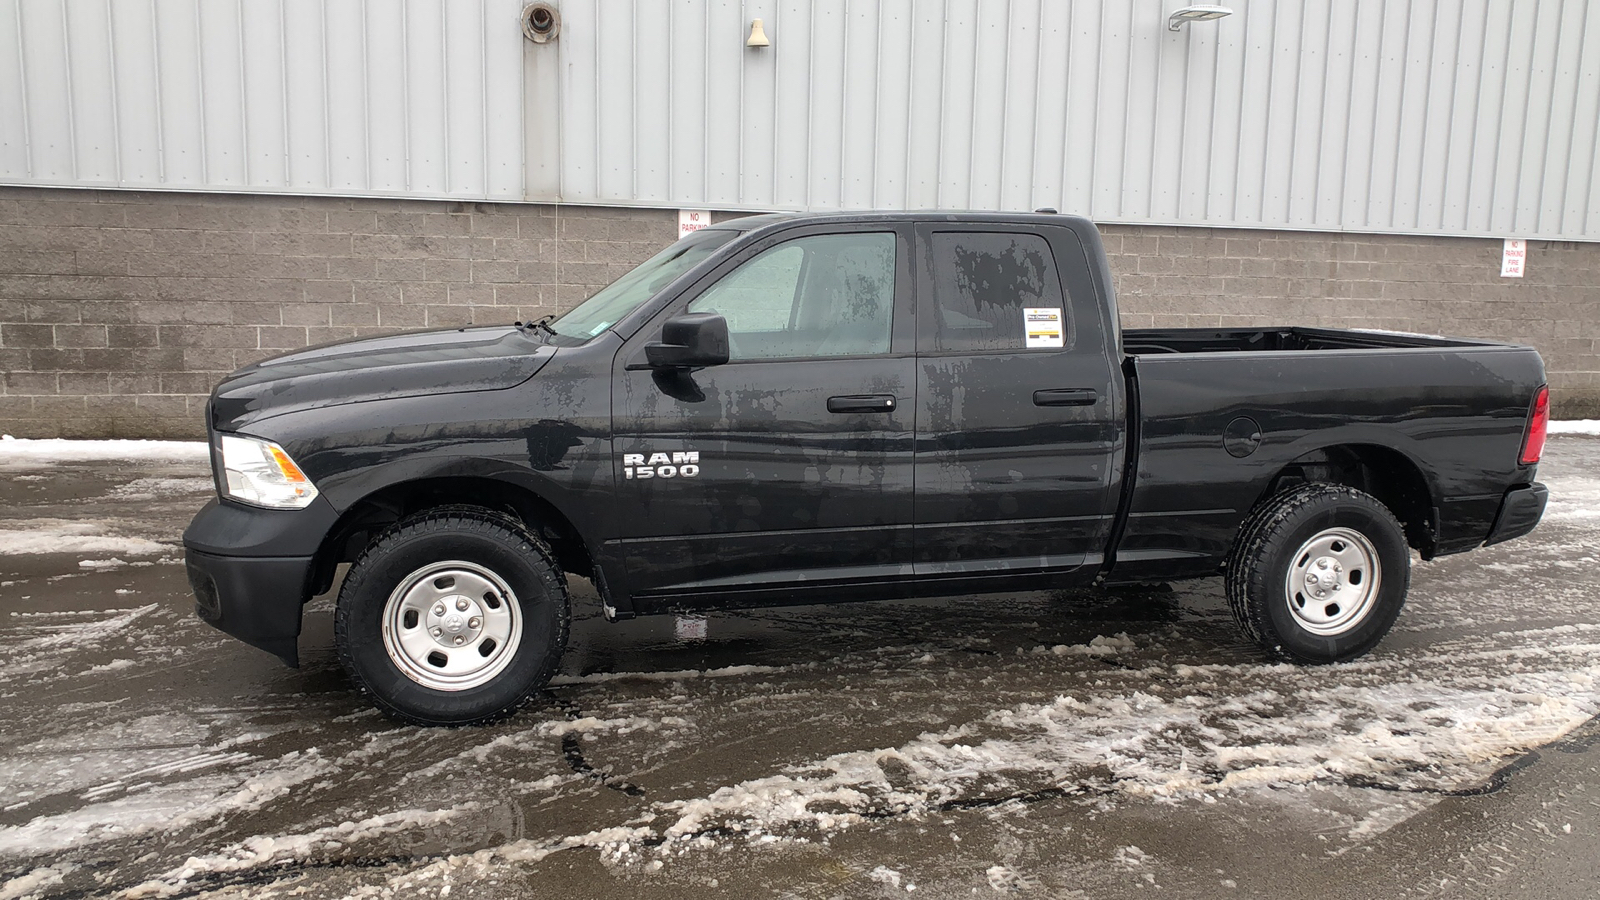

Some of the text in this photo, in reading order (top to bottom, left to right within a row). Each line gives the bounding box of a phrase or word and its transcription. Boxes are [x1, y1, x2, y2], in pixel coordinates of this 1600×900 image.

[690, 212, 699, 221] NO
[623, 451, 699, 466] RAM
[624, 465, 699, 479] 1500
